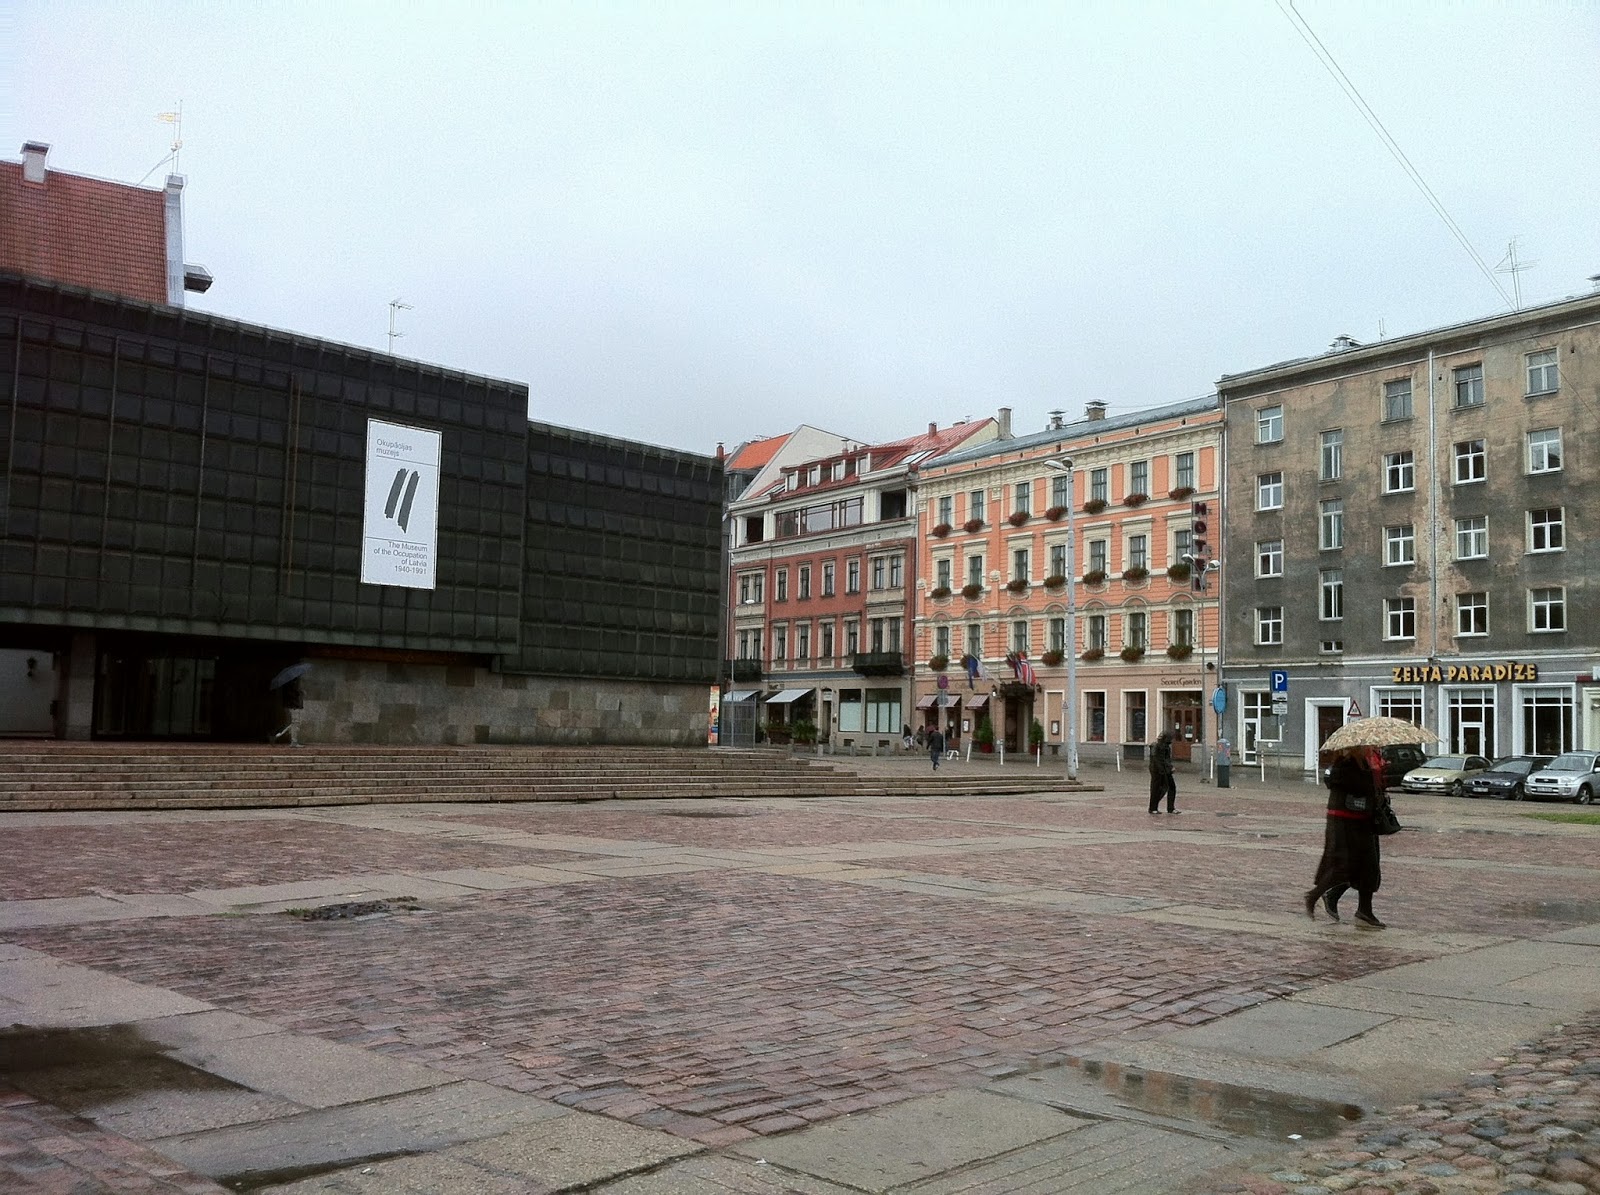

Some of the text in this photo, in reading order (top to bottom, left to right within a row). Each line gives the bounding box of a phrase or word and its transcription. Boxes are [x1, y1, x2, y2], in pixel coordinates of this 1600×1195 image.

[376, 447, 400, 458] muzejs
[388, 540, 428, 552] The Museum
[381, 548, 391, 556] the
[393, 549, 428, 560] Occupation
[409, 559, 427, 567] Latvia
[395, 565, 427, 575] 1940-1991
[1392, 662, 1536, 682] ZELTA PARADĪZE
[1275, 673, 1285, 689] P
